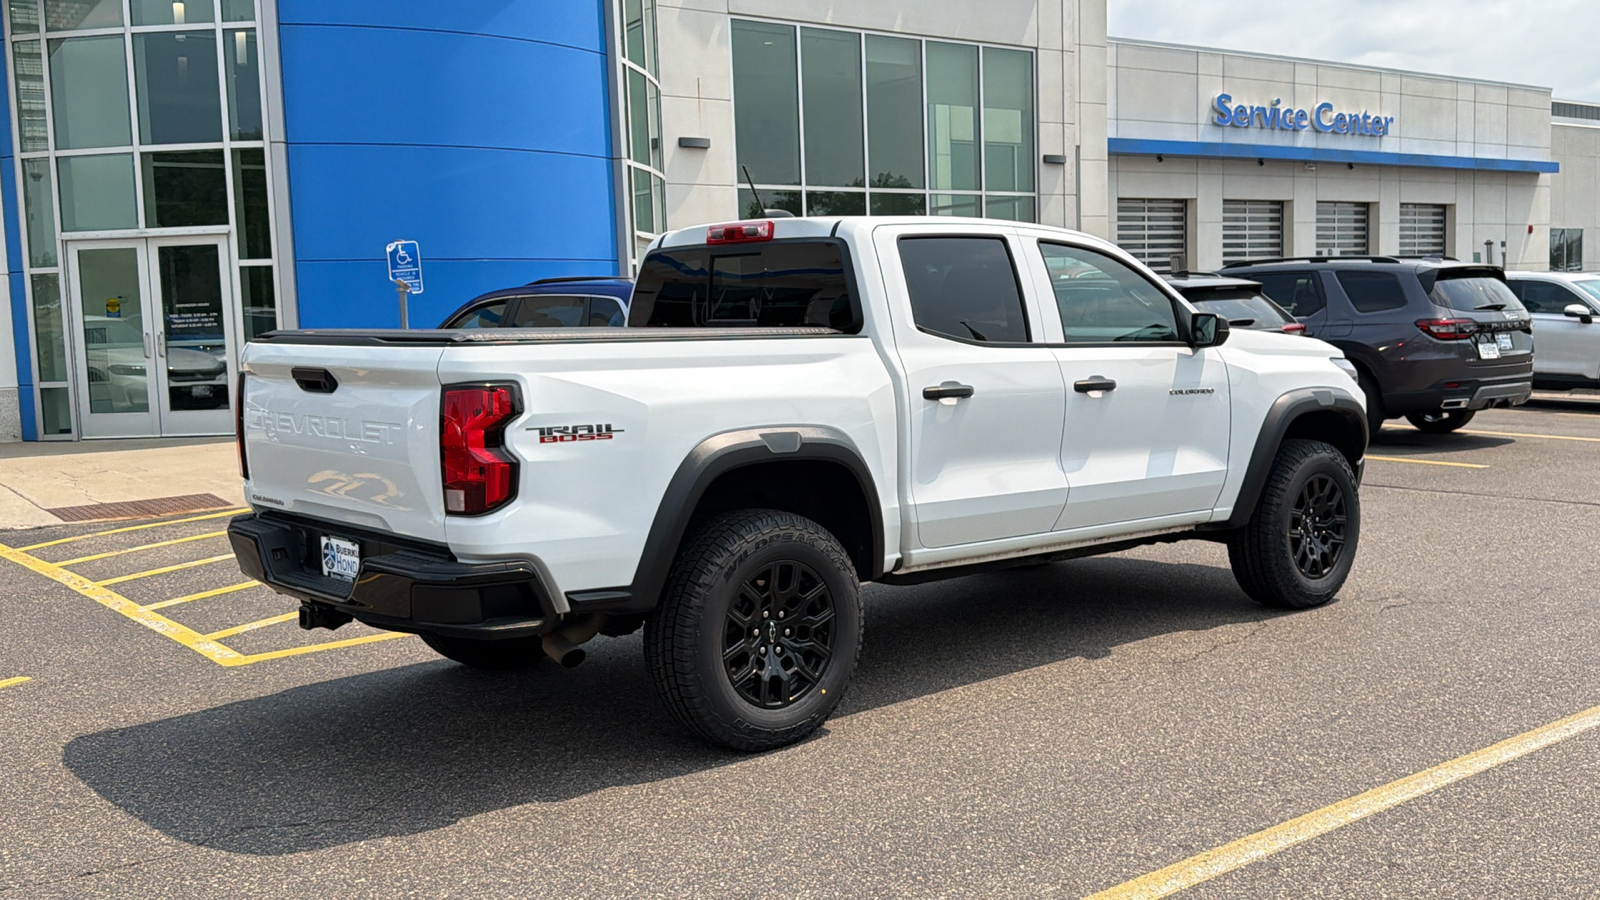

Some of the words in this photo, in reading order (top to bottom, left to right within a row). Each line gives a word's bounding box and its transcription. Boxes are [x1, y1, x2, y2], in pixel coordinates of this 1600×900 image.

[1213, 93, 1308, 131] Service
[1312, 102, 1394, 136] Center
[1169, 388, 1215, 396] COLORADO
[247, 409, 401, 445] CHEVROLET
[525, 423, 625, 437] TRAIL
[539, 432, 613, 444] BOSS
[335, 543, 359, 558] BUERKL
[722, 531, 819, 584] WILDPEAK
[336, 554, 358, 574] HOND
